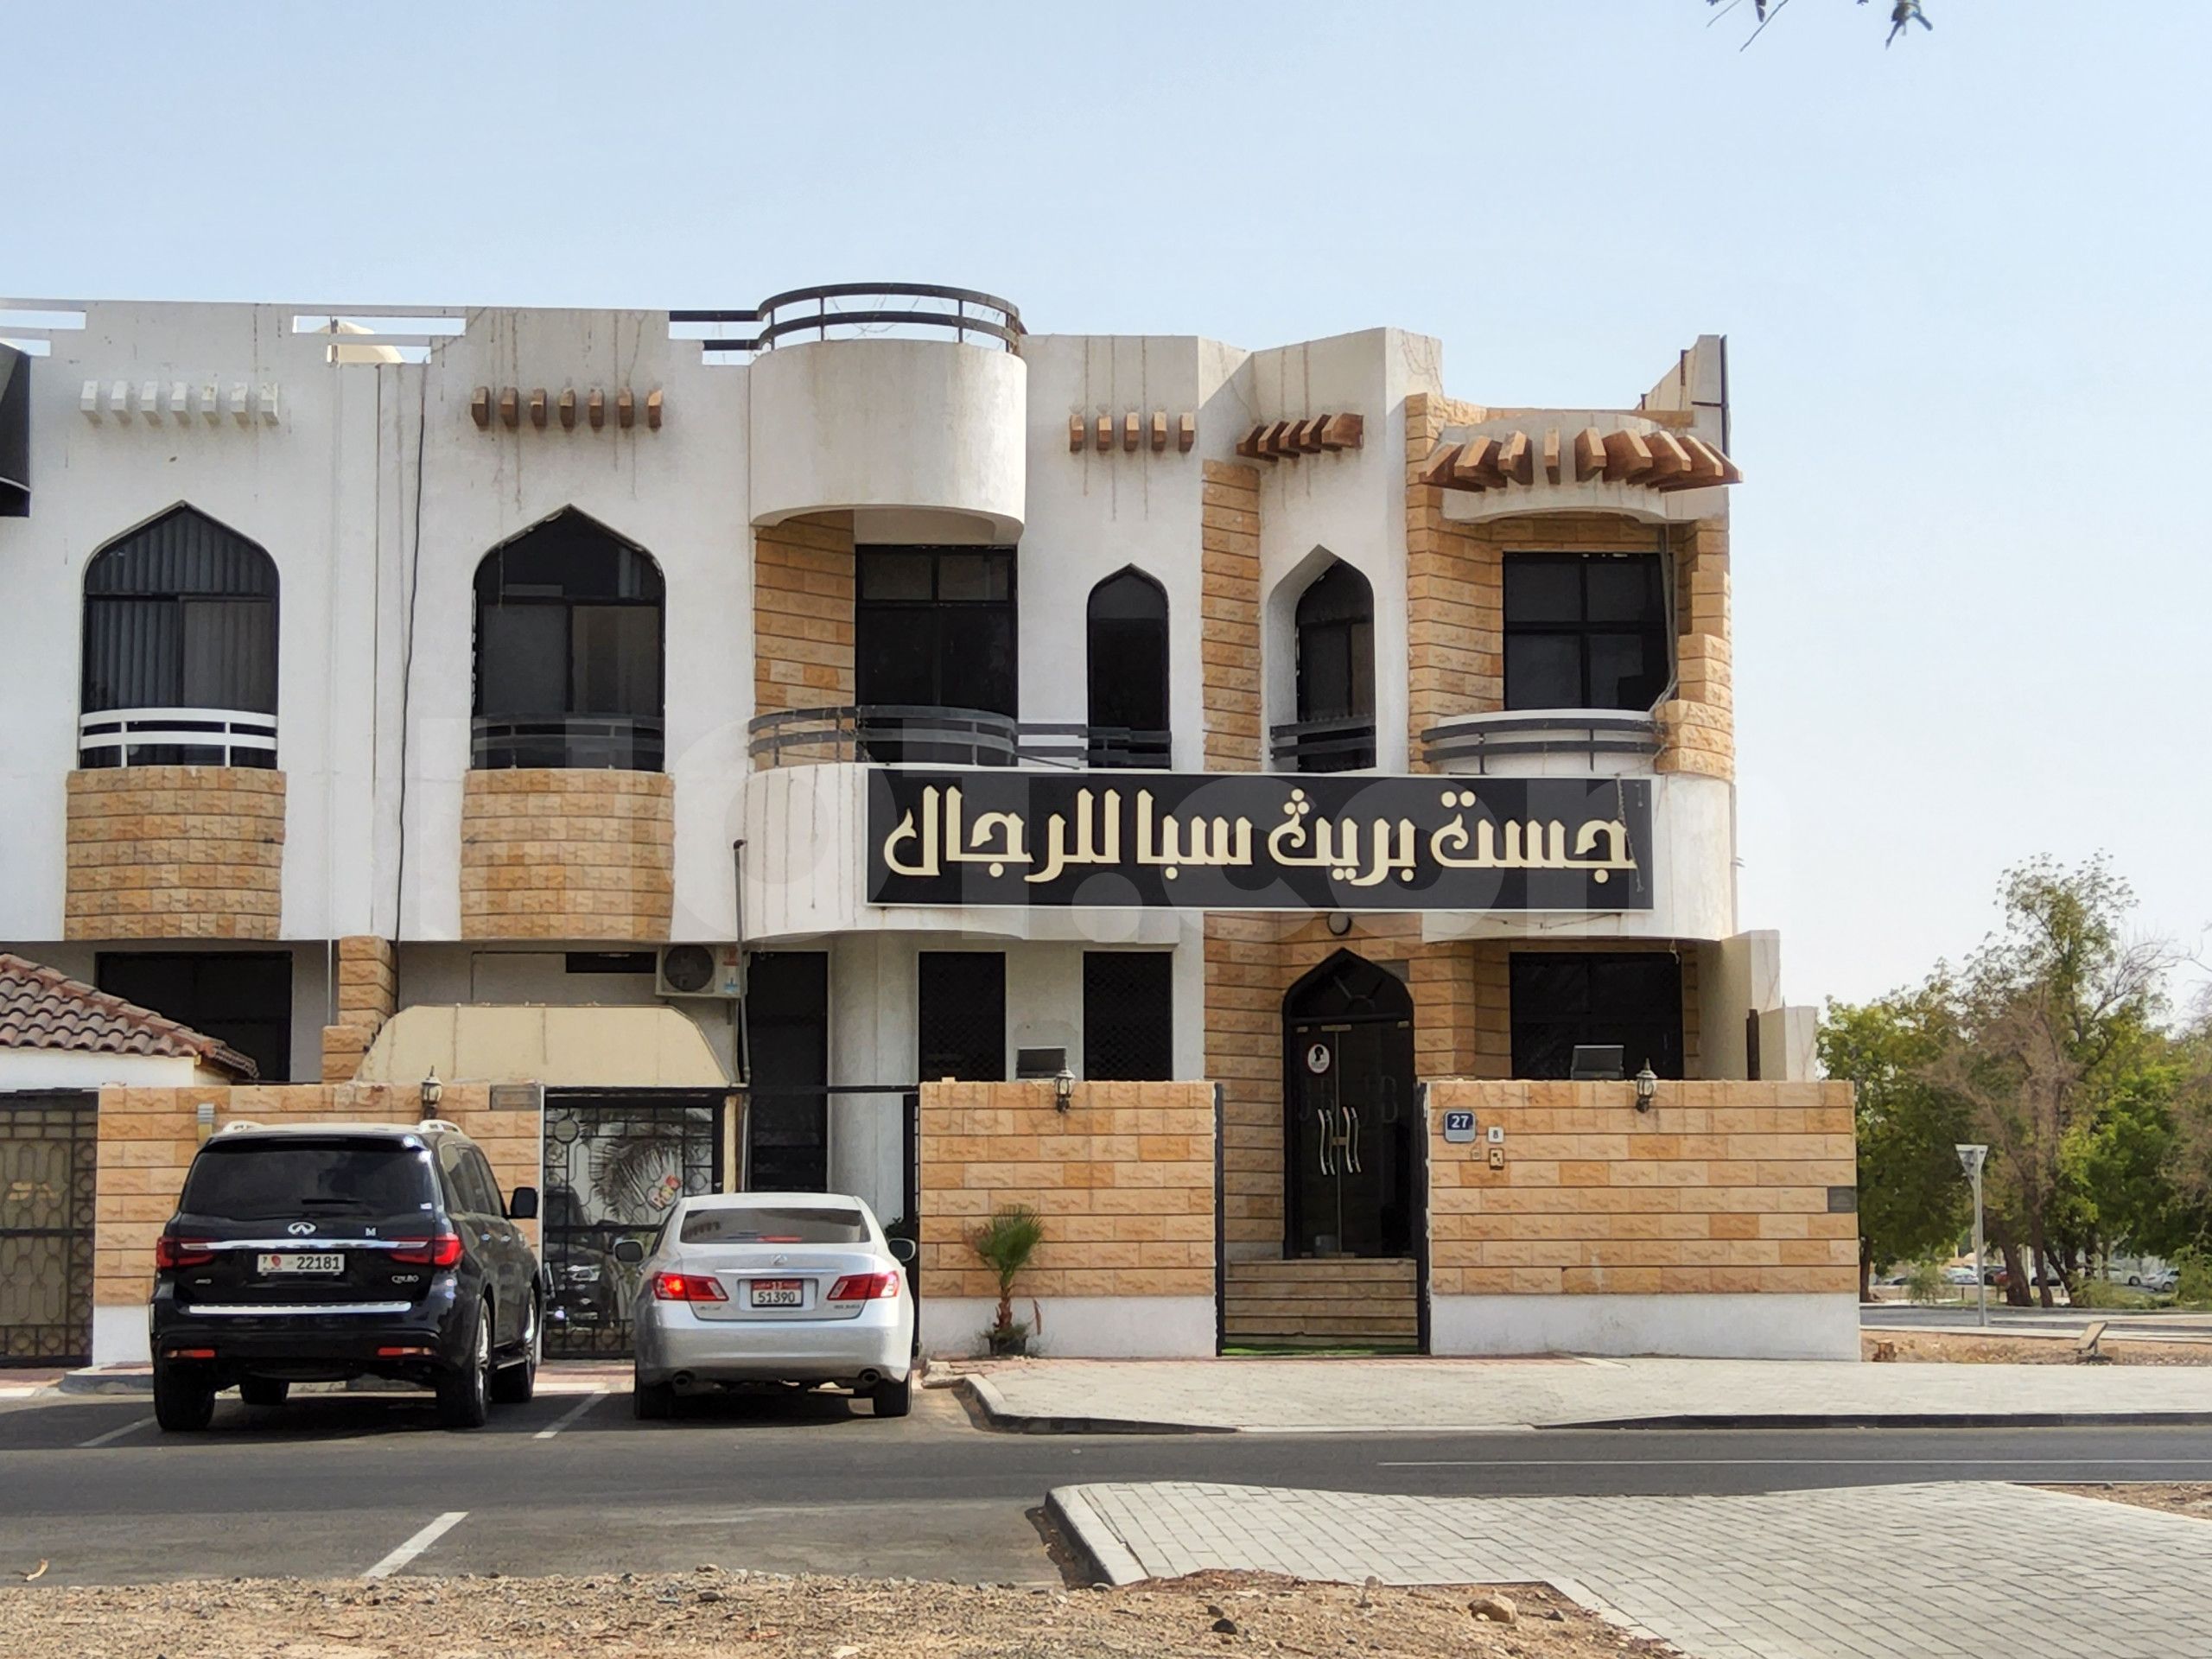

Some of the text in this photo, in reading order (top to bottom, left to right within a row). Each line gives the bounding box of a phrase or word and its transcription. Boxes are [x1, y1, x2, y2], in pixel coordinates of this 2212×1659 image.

[883, 785, 1639, 887] جست بريث سبا للرجال
[1452, 1116, 1469, 1128] 27
[296, 1256, 340, 1270] 22181
[758, 1291, 796, 1303] 51390
